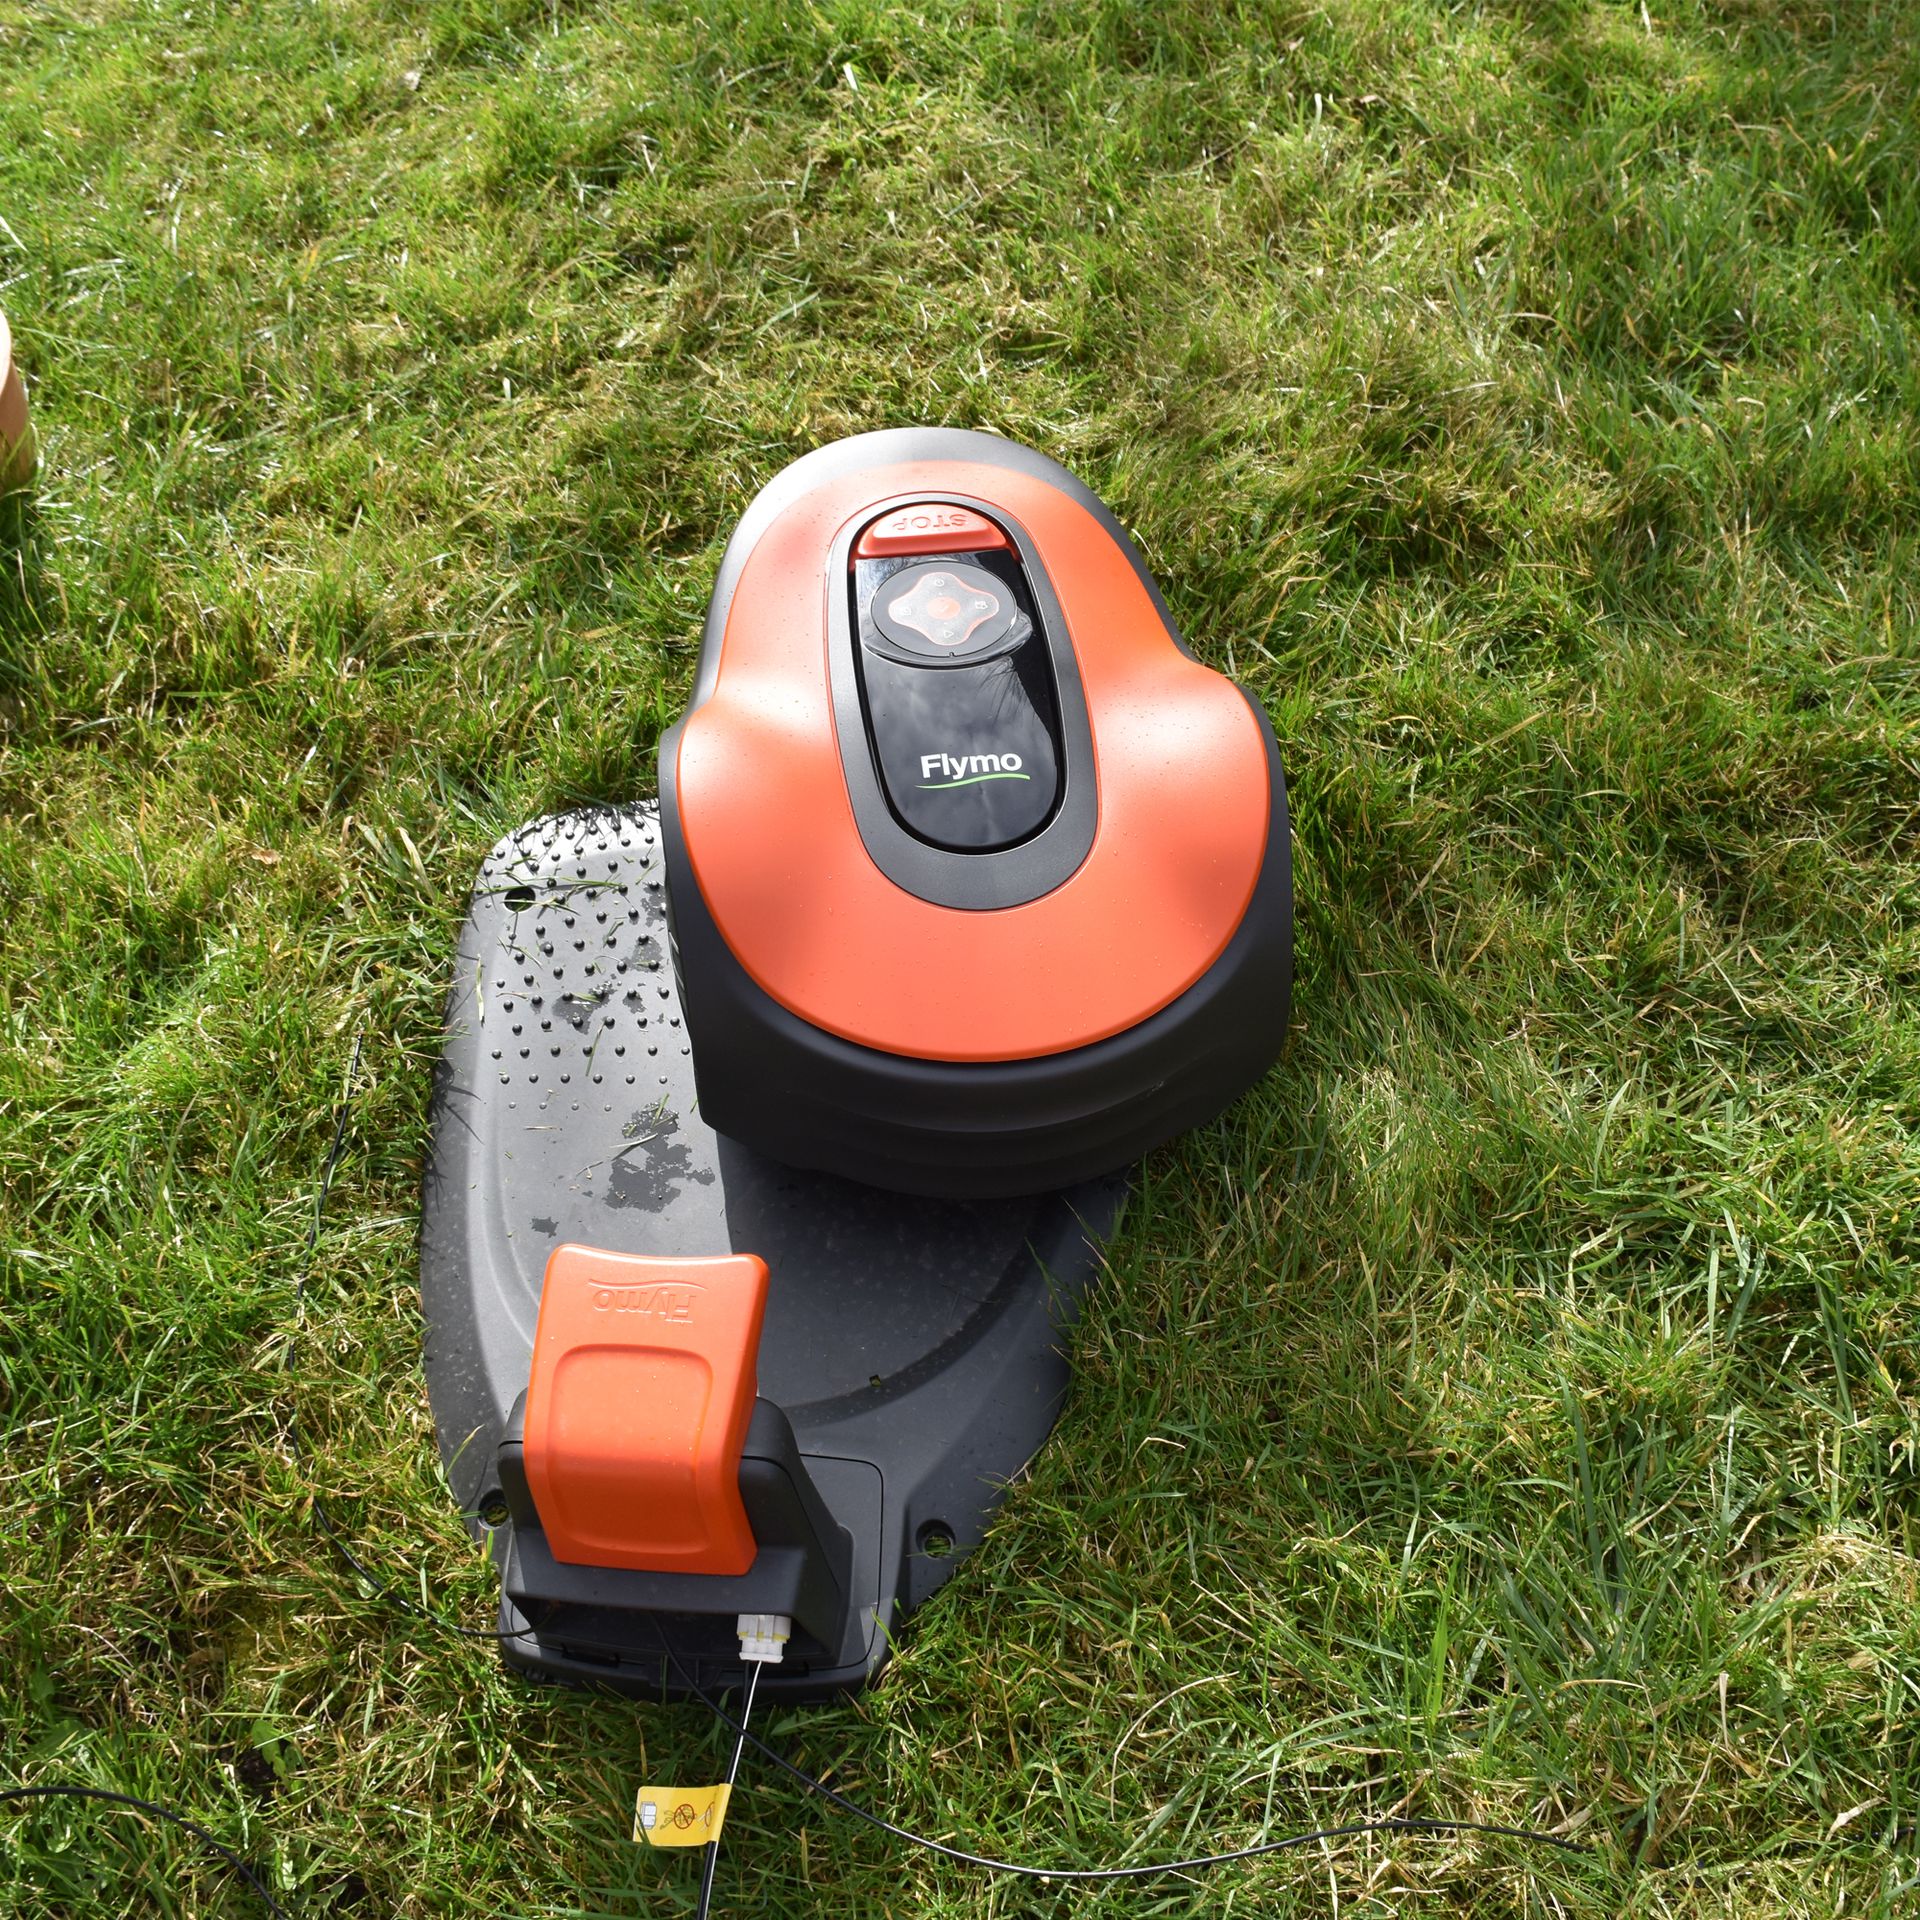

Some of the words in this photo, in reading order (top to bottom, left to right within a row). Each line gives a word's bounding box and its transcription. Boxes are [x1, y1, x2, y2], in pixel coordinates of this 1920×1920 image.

[892, 513, 968, 531] STOP
[920, 752, 1023, 780] Flymo
[592, 1287, 697, 1324] Flymo
